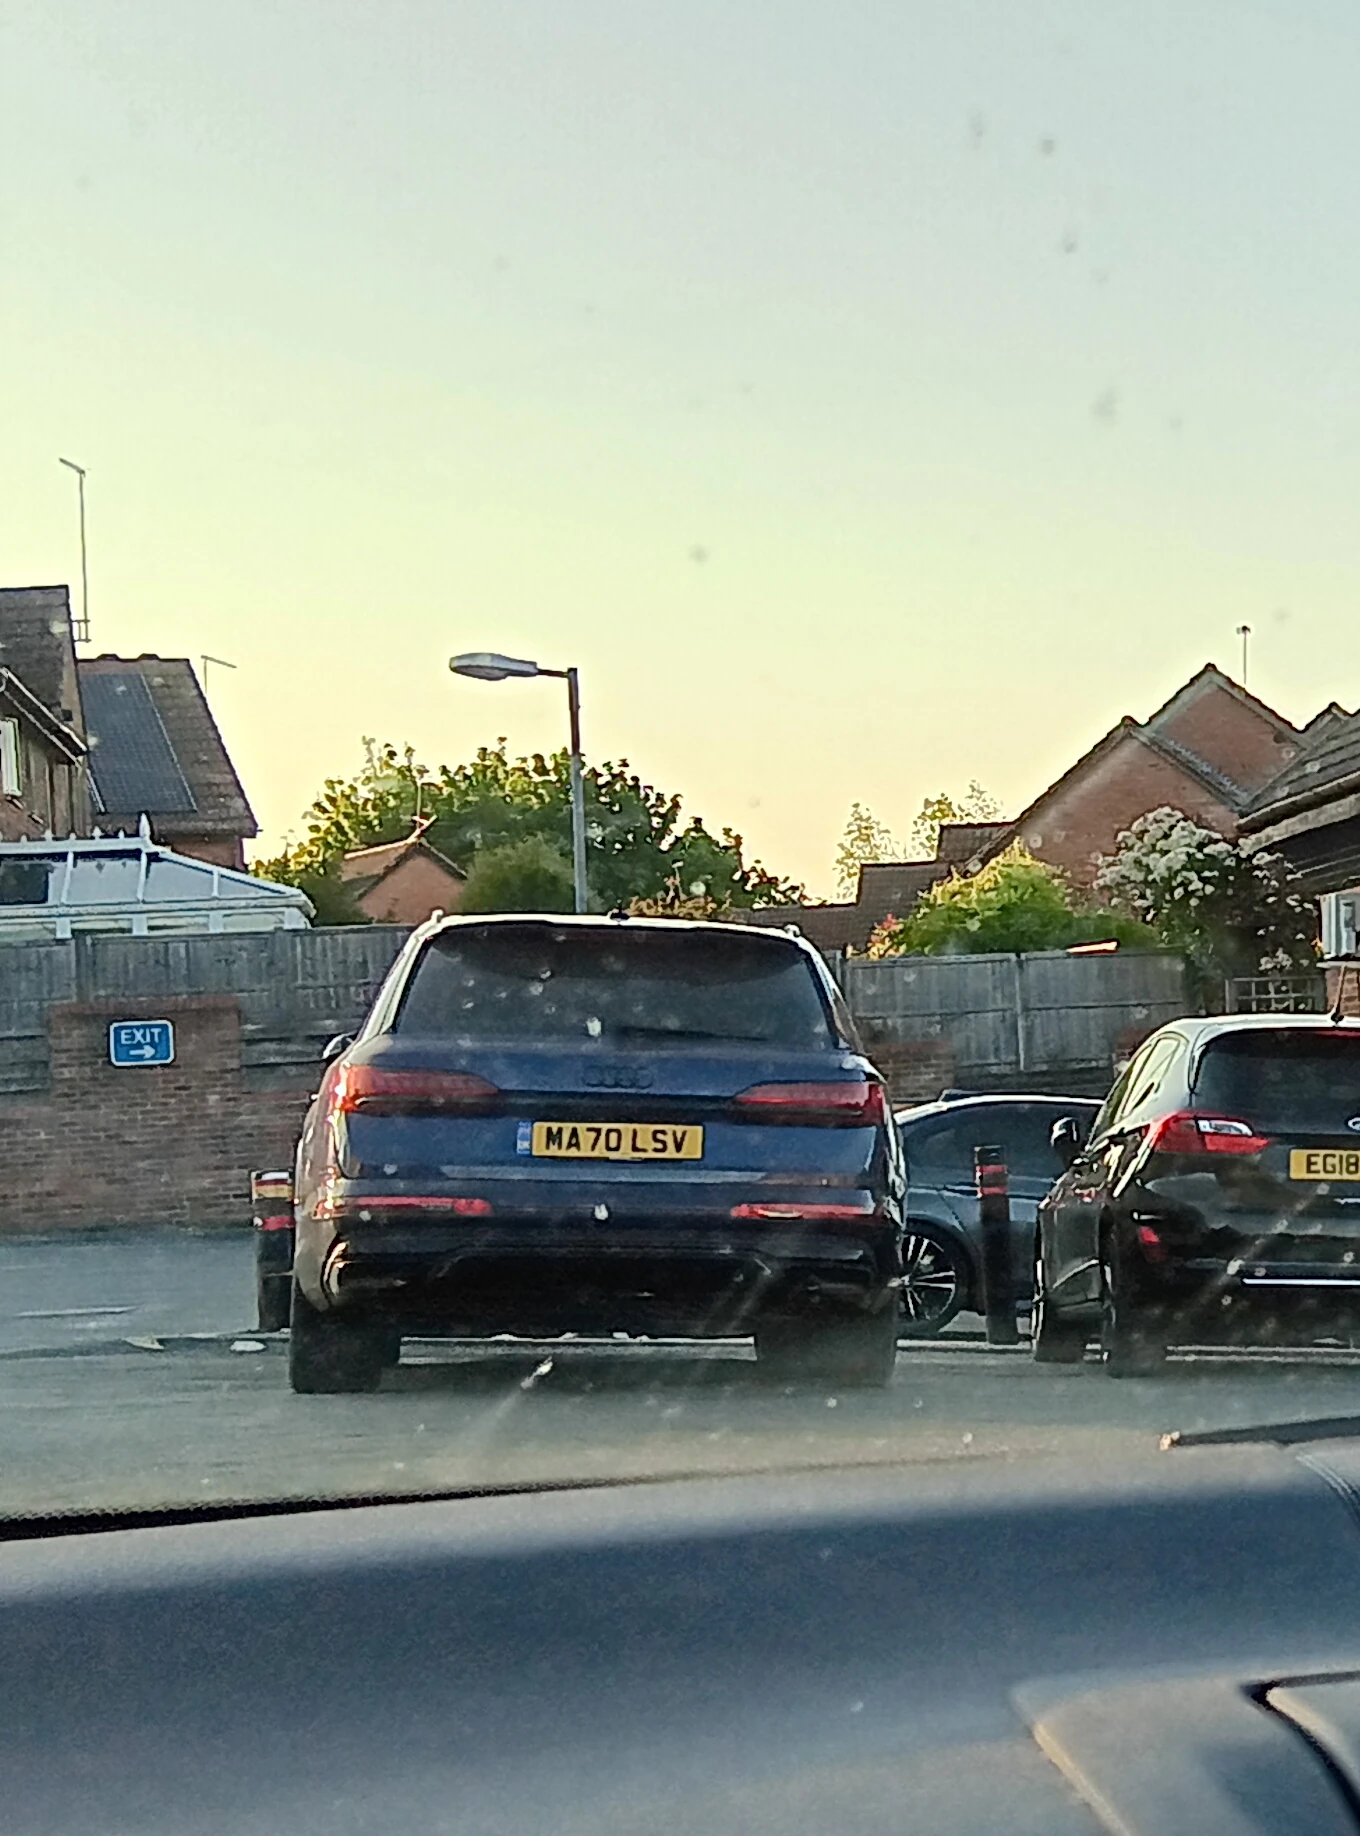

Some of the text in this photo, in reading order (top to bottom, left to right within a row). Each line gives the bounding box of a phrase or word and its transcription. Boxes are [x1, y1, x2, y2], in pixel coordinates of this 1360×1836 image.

[120, 1027, 162, 1045] EXIT
[545, 1126, 687, 1153] MA70 LSV
[1306, 1153, 1360, 1175] EG18
